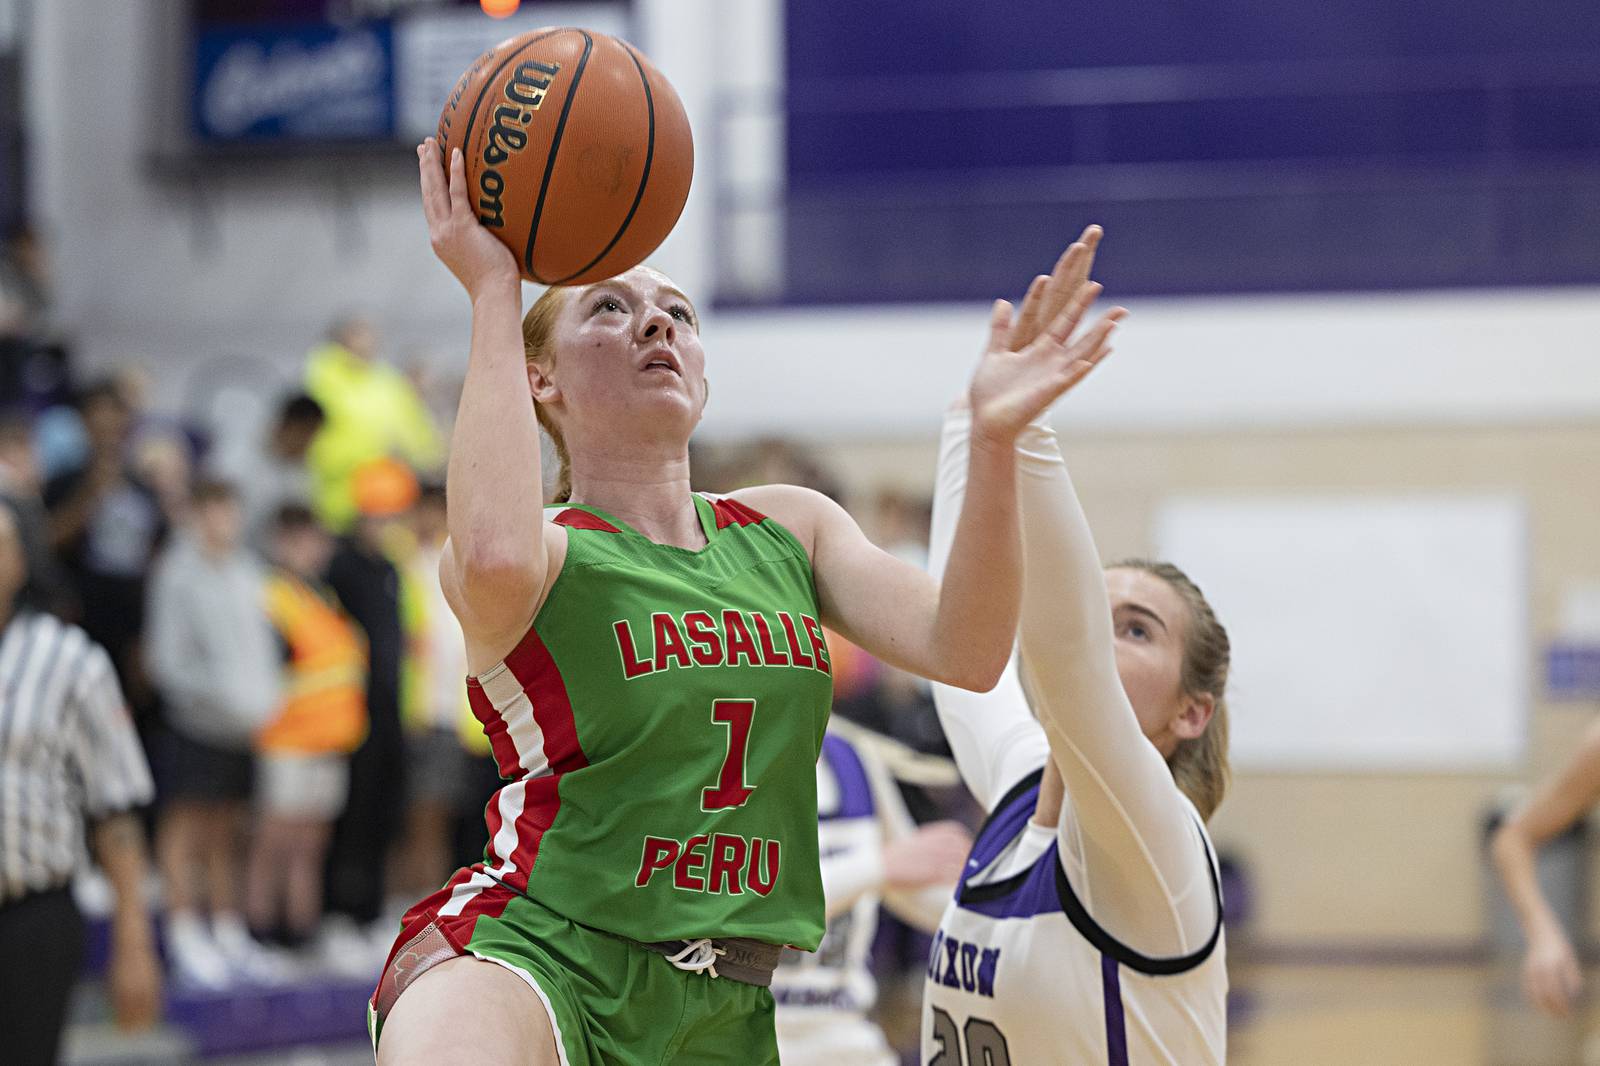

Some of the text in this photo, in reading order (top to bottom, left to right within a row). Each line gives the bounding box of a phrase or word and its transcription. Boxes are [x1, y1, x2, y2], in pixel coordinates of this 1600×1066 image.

[479, 60, 560, 228] Wilson
[612, 609, 831, 681] LASALLE
[700, 699, 757, 813] 1
[635, 832, 780, 898] PERU
[928, 930, 1000, 998] IXON
